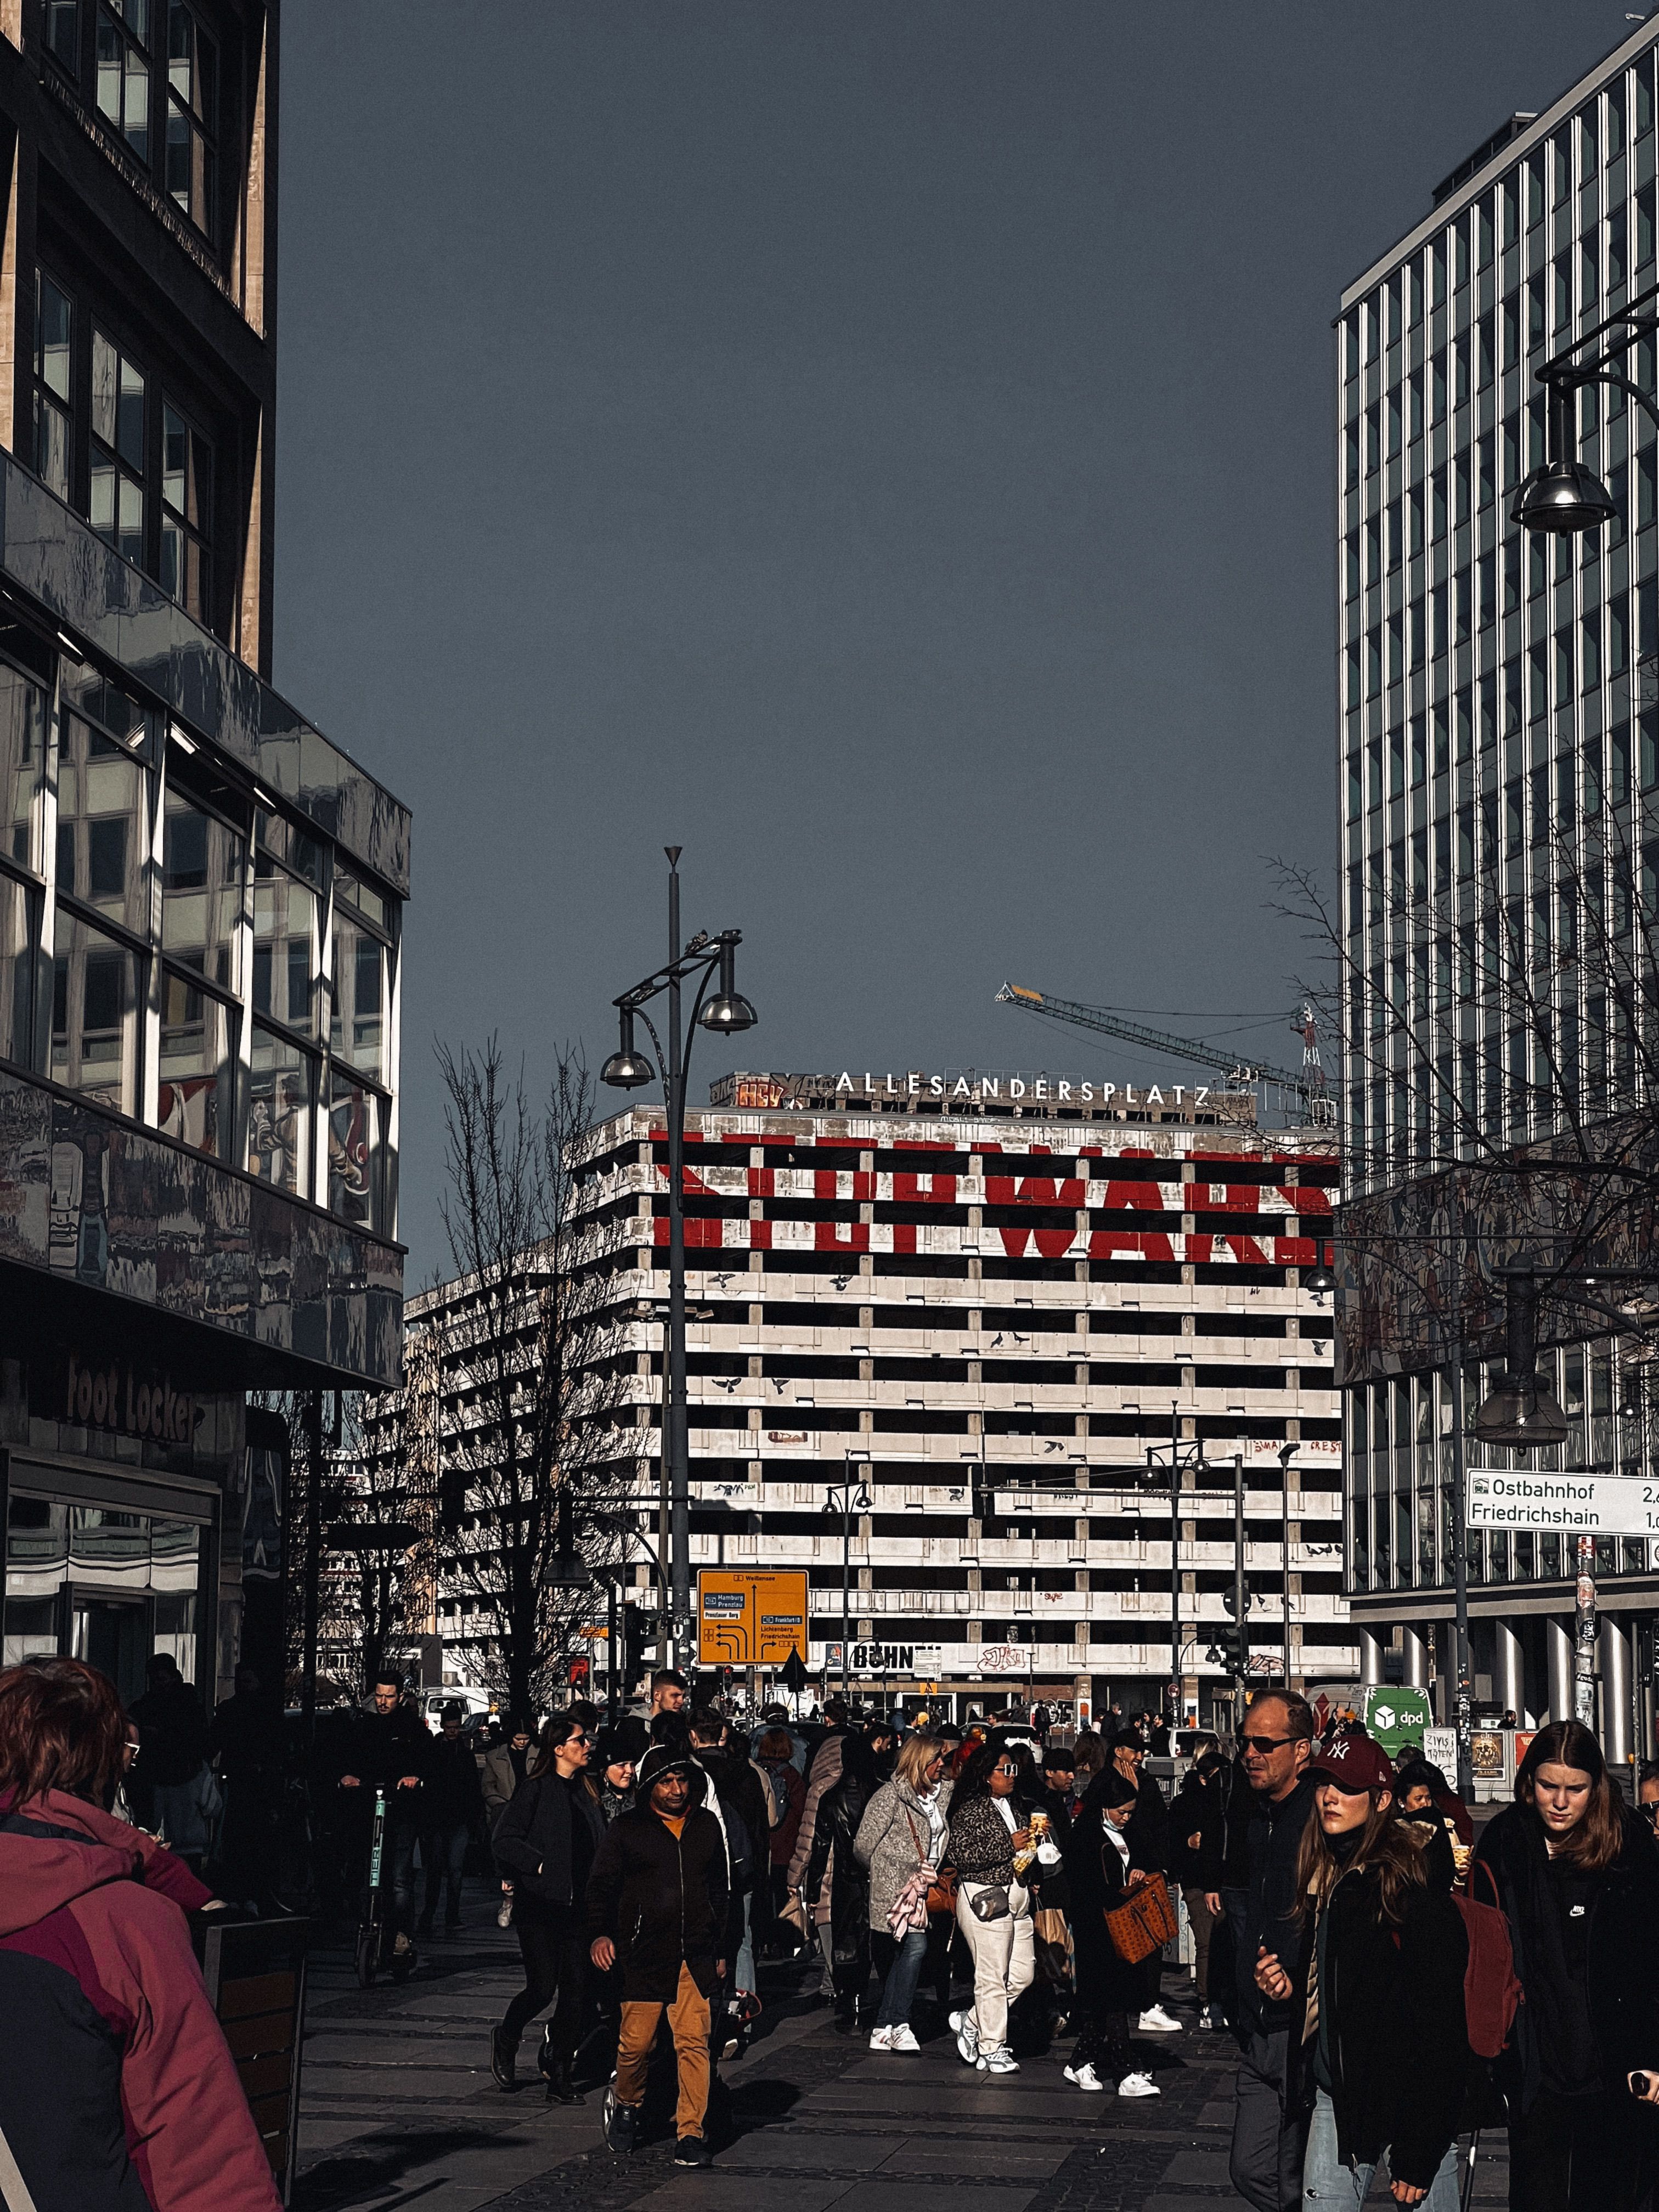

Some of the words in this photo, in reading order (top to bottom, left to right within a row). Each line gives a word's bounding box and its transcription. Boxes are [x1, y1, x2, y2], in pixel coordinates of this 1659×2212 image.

[836, 1071, 1211, 1106] ALLESANDERSPLATZ
[67, 1348, 119, 1426] Foot
[126, 1365, 195, 1444] Locker
[1493, 1479, 1595, 1499] Ostbahnhof
[1472, 1503, 1599, 1525] Friedrichshain
[1400, 1711, 1424, 1726] dpd
[1327, 1740, 1350, 1759] NY
[370, 1849, 380, 1884] TIER
